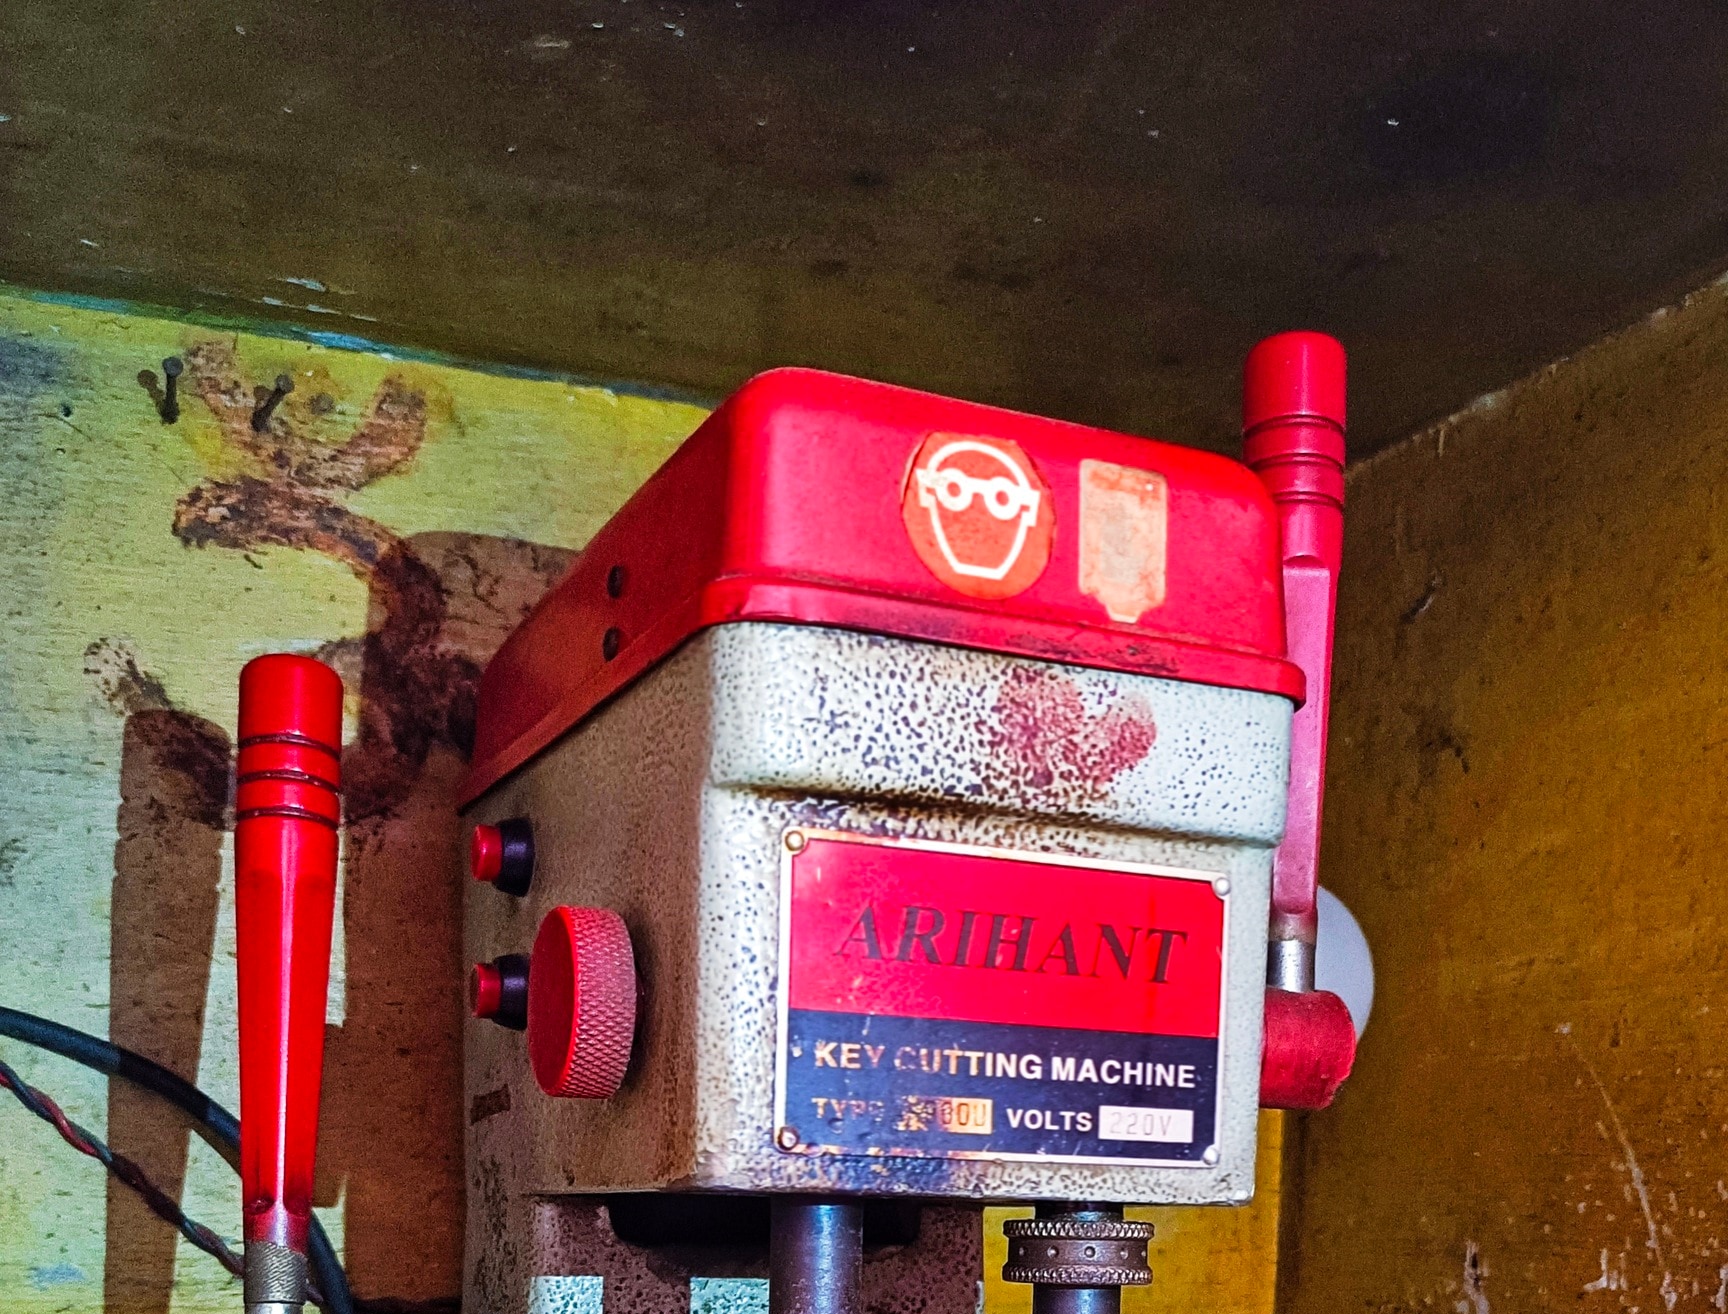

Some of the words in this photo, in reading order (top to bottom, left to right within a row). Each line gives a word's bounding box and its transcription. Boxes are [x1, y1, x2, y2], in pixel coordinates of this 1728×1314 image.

[834, 900, 1188, 984] ARIHANT
[814, 1039, 884, 1070] KEY
[893, 1043, 1042, 1082] CUTTING
[1050, 1056, 1196, 1089] MACHINE
[1006, 1107, 1093, 1133] VOLTS
[1109, 1111, 1175, 1137] 220V
